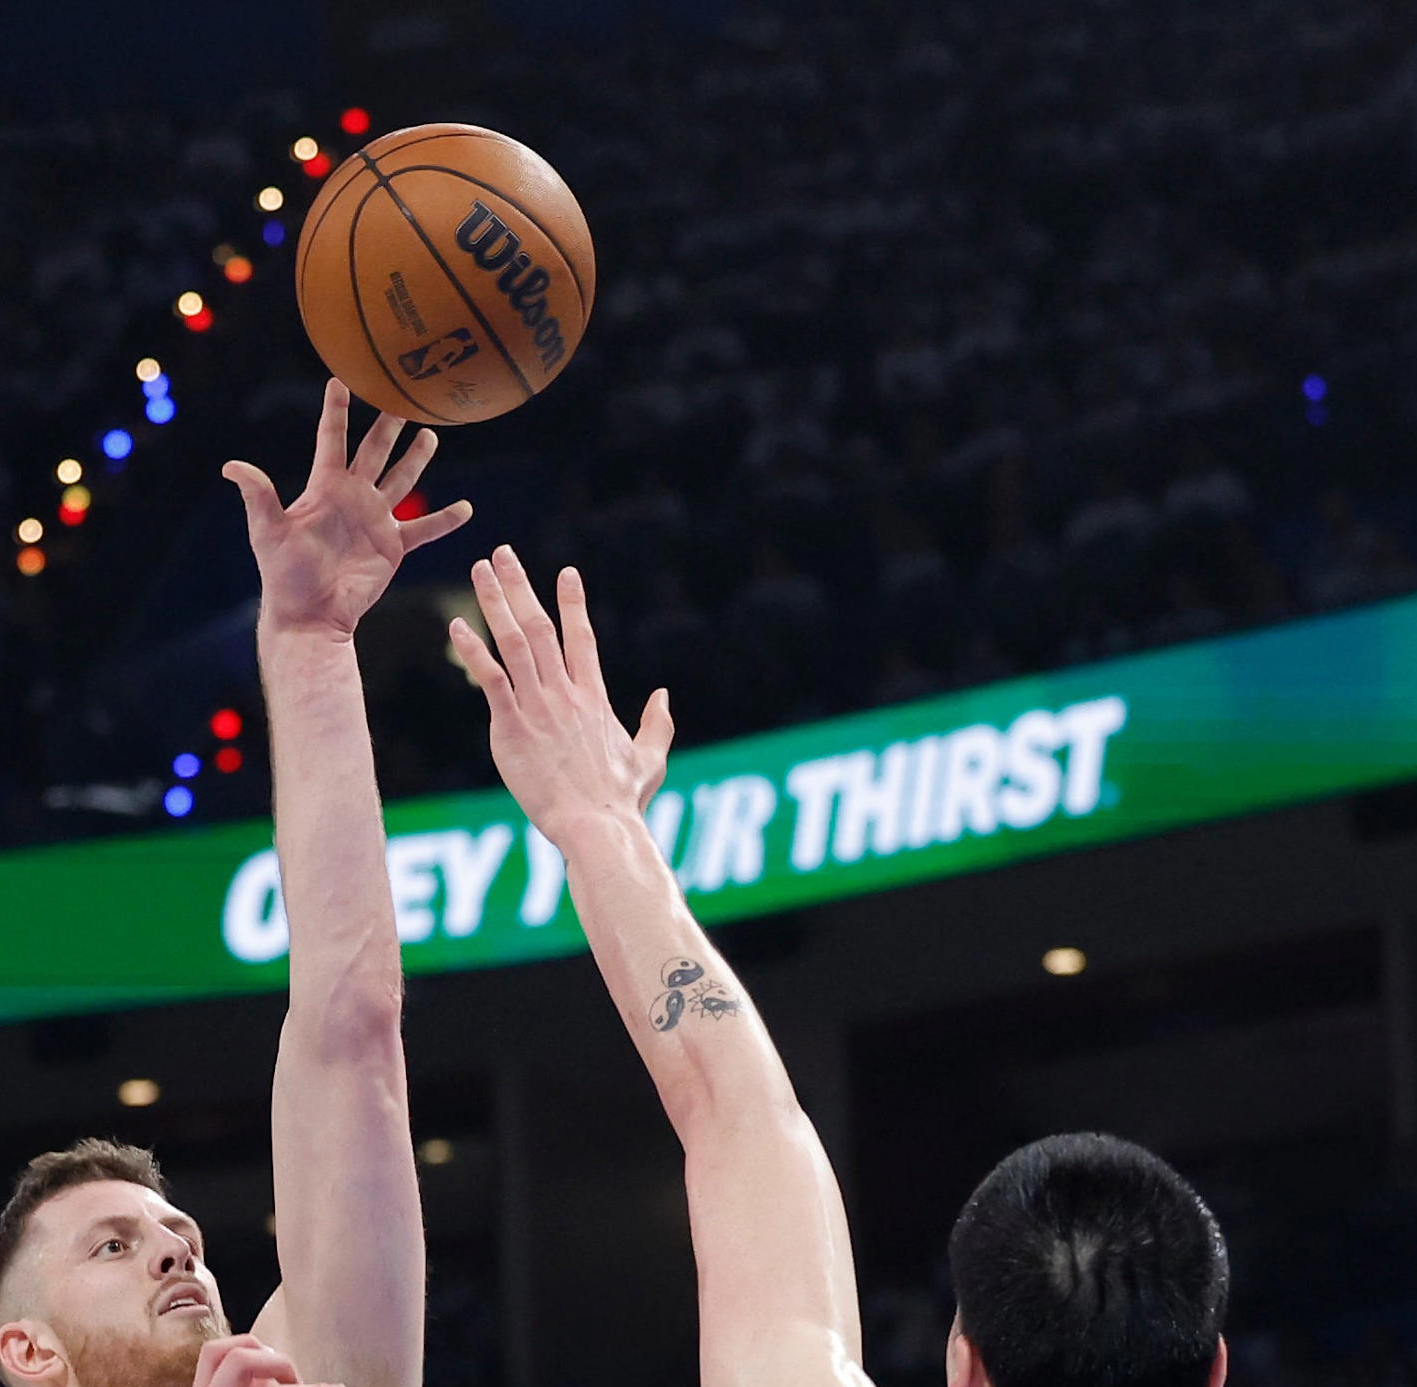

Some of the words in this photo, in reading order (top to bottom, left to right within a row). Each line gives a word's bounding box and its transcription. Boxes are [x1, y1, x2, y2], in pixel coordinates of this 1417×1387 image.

[454, 198, 566, 374] Wilson
[220, 822, 511, 964] OEY
[786, 696, 1127, 872] THIRST
